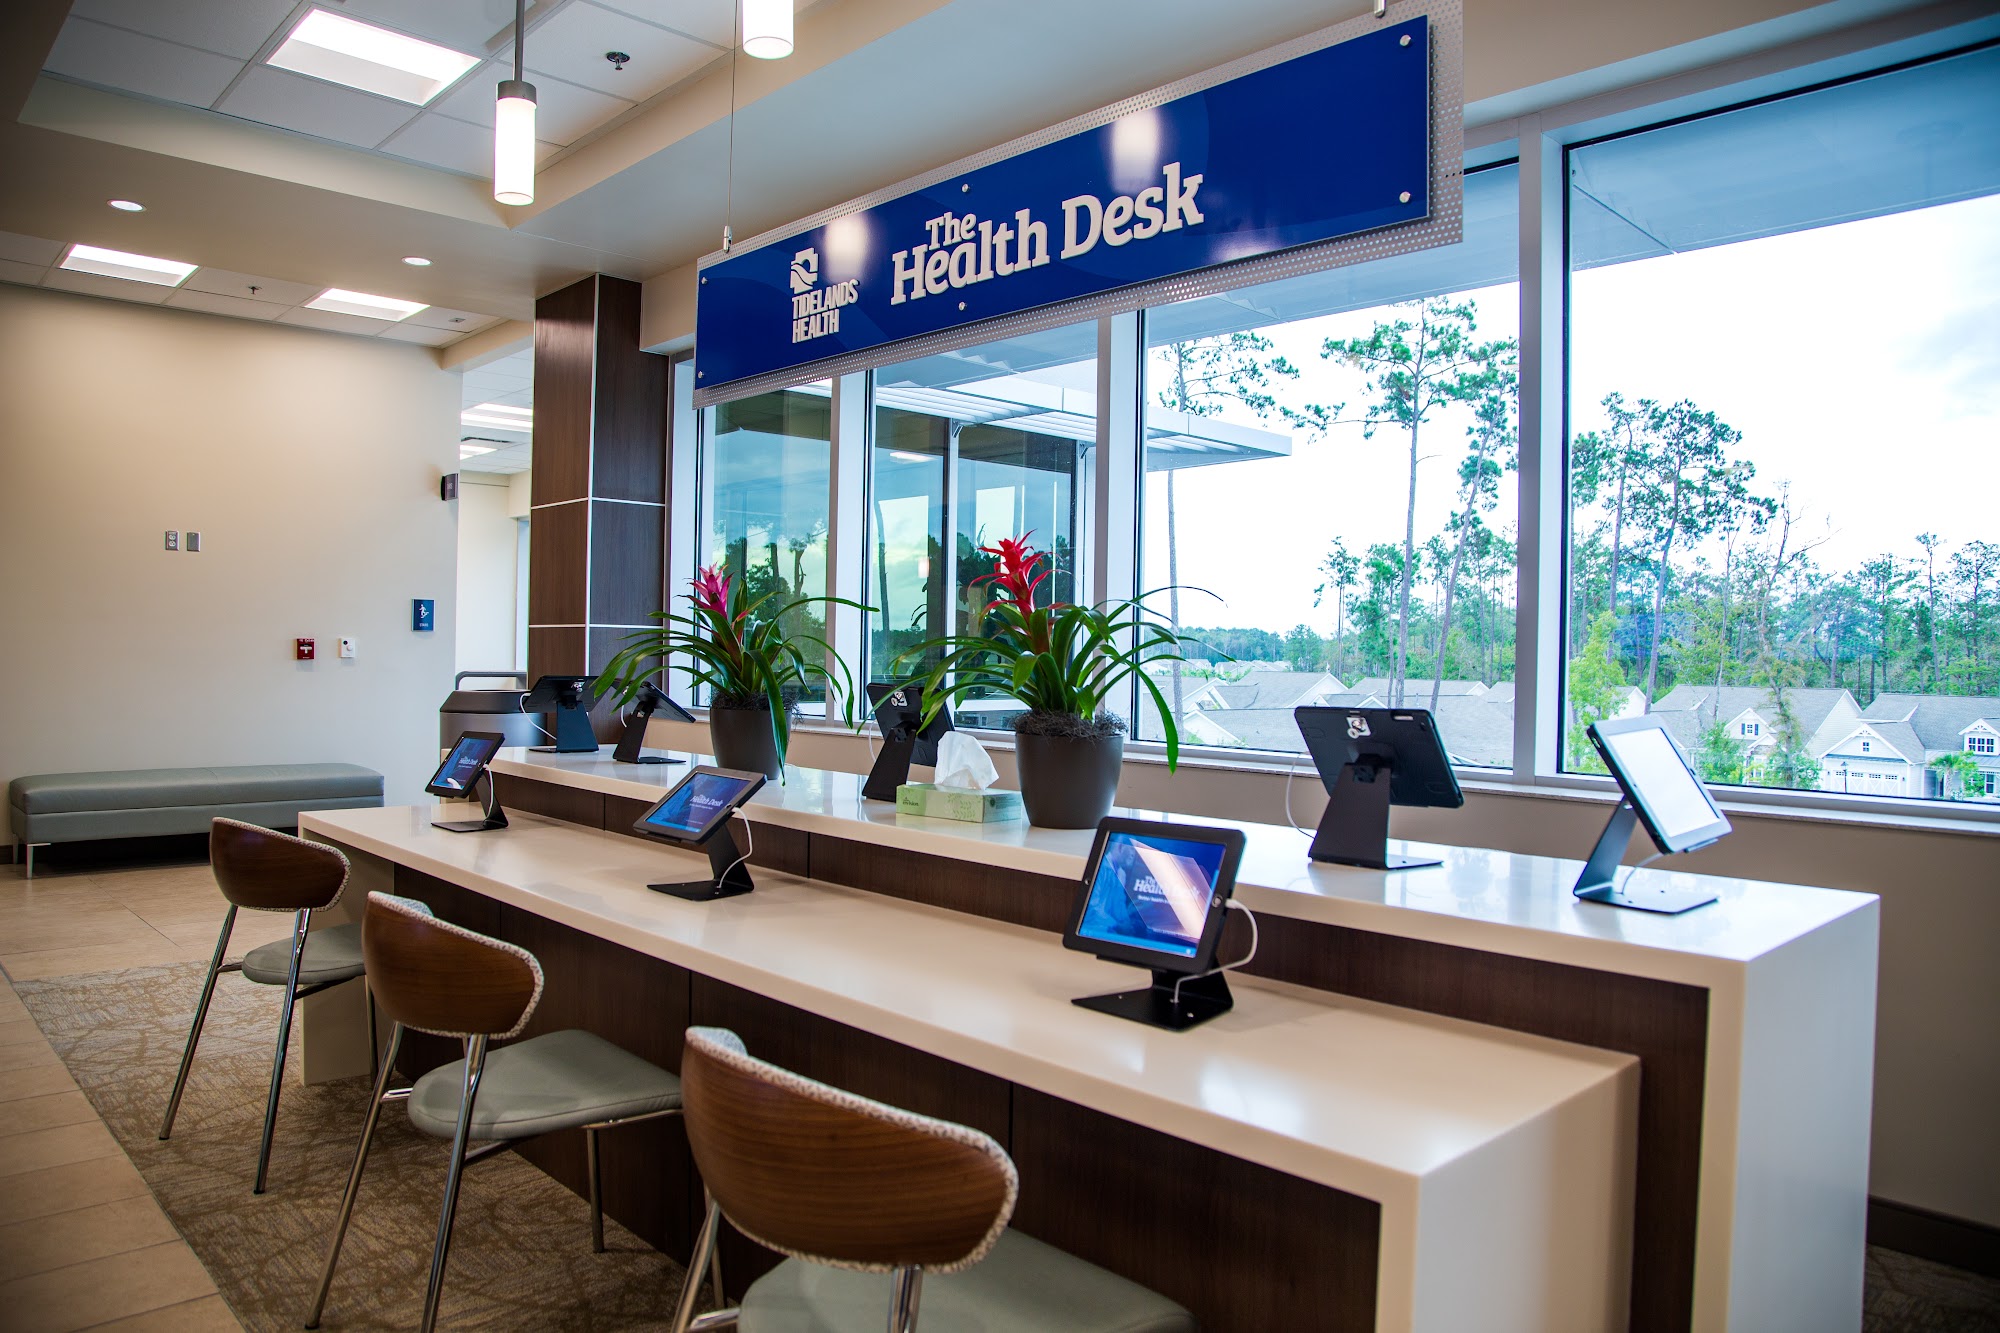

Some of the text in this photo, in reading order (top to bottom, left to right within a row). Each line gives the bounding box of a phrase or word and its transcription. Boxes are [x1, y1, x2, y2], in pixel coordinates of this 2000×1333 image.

[891, 161, 1205, 305] Health Desk
[925, 211, 976, 251] The
[792, 278, 859, 320] TIDELANDS
[792, 308, 840, 343] HEALTH
